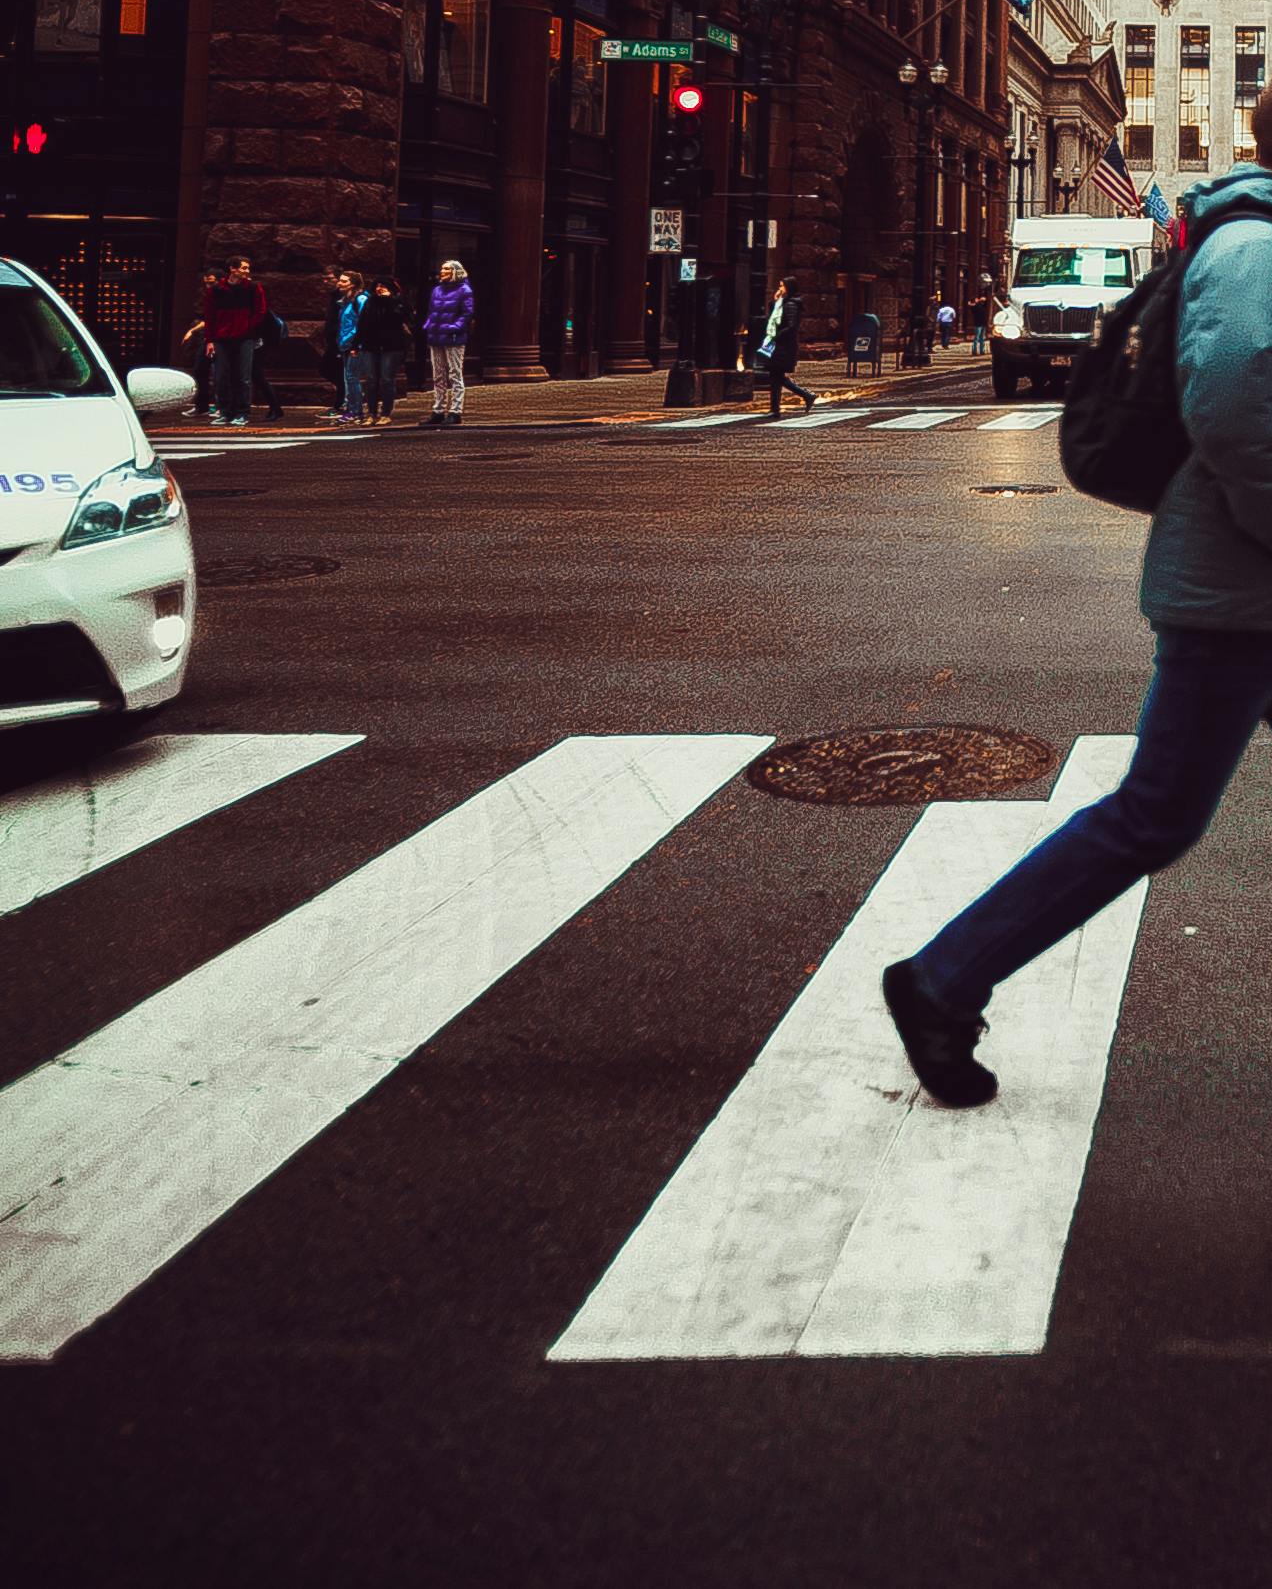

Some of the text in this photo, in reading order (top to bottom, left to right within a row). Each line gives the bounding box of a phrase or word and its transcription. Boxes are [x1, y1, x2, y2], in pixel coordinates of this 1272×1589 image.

[632, 43, 677, 58] Adams
[655, 211, 681, 224] ONE
[654, 223, 681, 235] WAY
